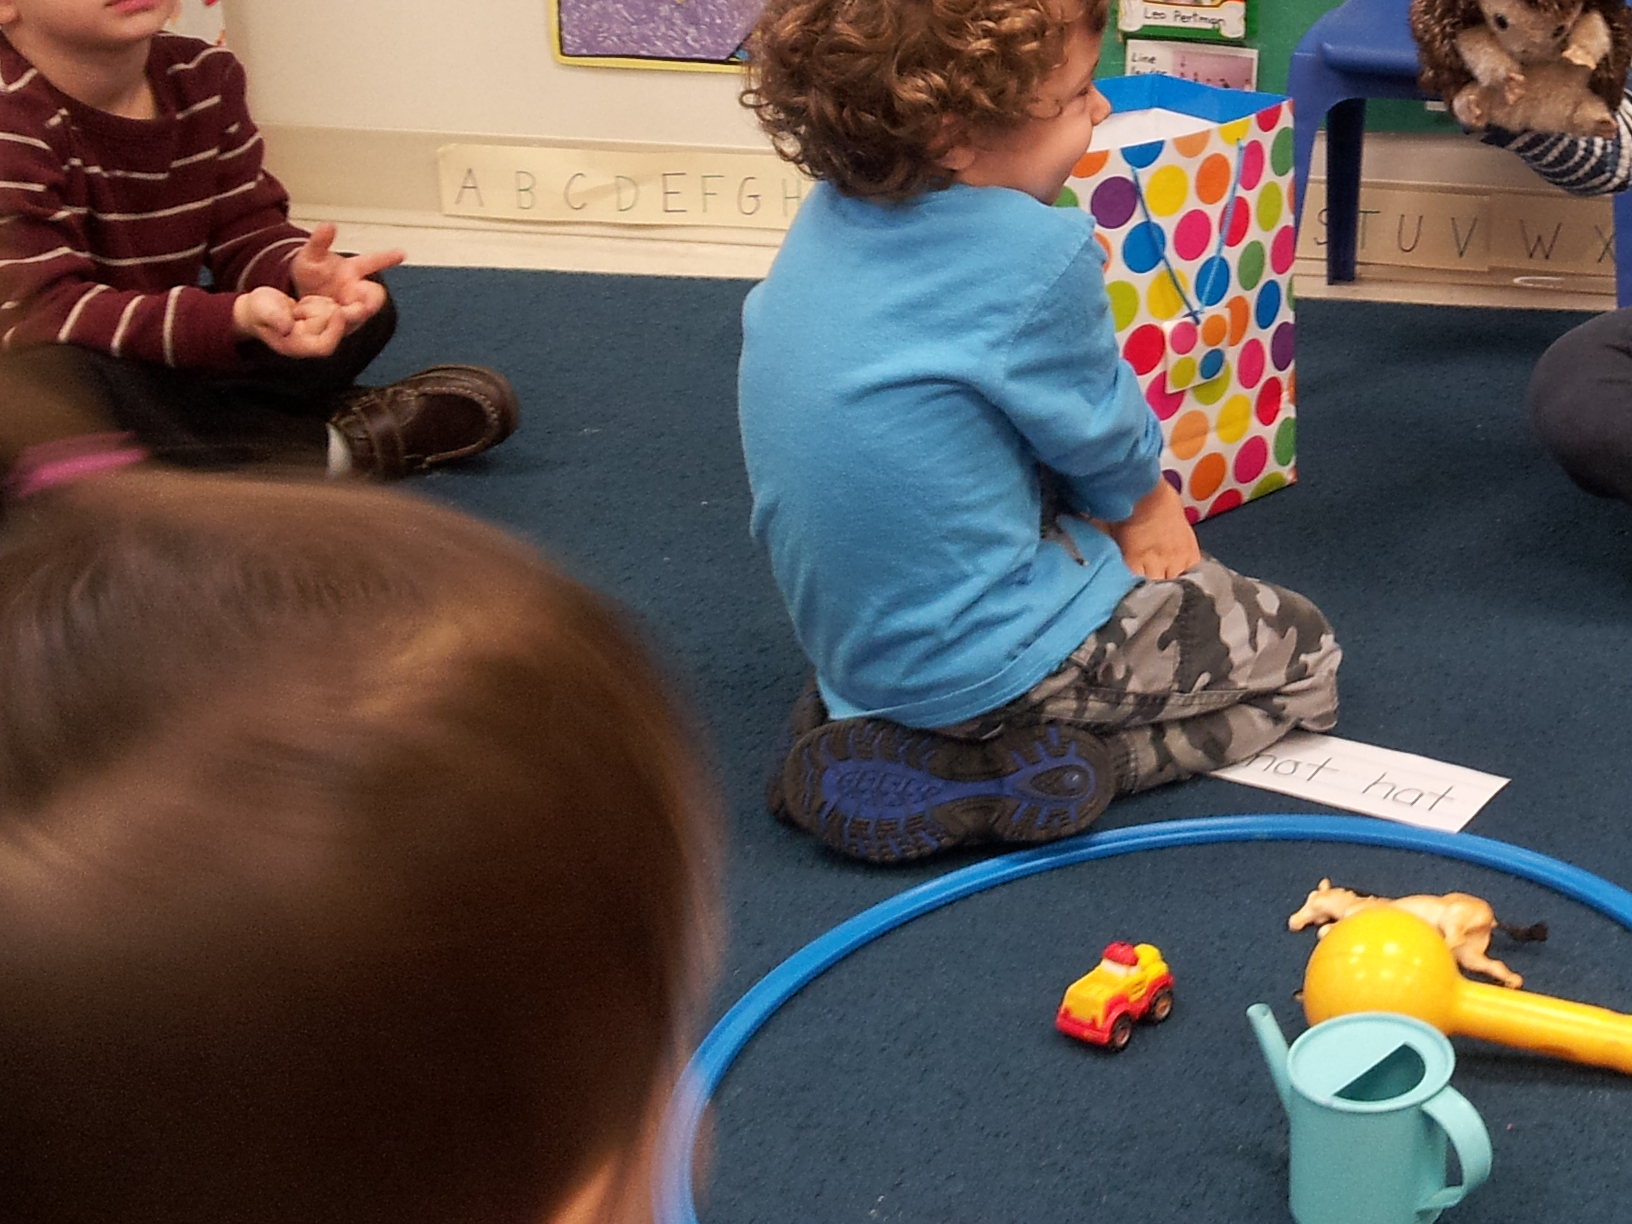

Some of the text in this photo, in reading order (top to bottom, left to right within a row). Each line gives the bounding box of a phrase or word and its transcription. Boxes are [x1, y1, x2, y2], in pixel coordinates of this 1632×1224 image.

[1144, 7, 1166, 19] Leo
[455, 168, 801, 217] A B C D E F G H
[1400, 214, 1424, 253] U
[1451, 217, 1478, 258] V
[1519, 219, 1562, 260] W
[1362, 772, 1455, 811] hat
